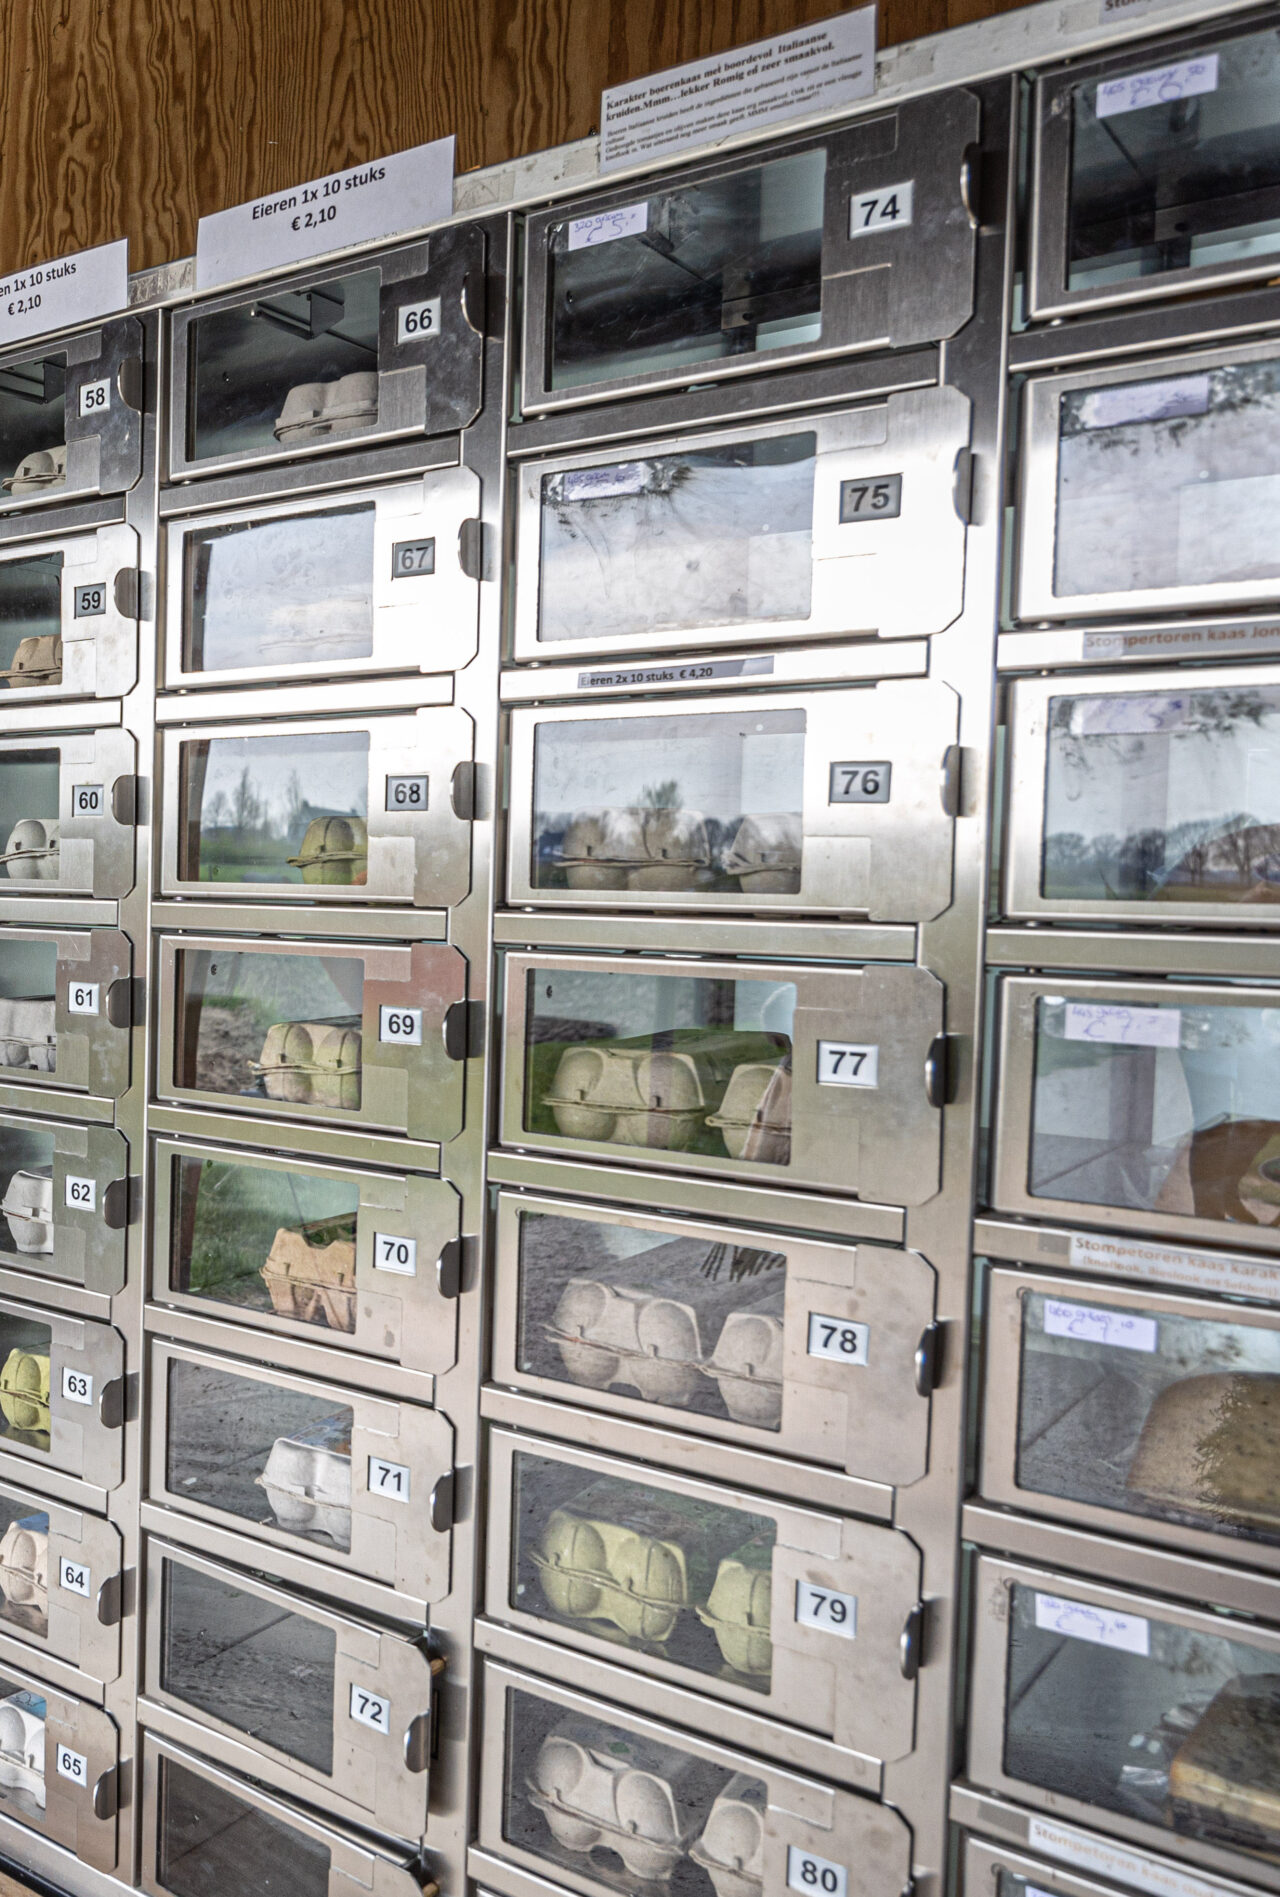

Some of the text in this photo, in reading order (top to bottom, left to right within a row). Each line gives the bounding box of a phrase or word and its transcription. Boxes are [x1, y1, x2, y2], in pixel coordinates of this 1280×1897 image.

[607, 91, 647, 110] Karakter
[649, 73, 701, 96] boerenkaas
[724, 48, 772, 72] boordevol
[778, 32, 827, 54] Italiaanse
[713, 70, 744, 87] Romig
[252, 167, 386, 221] Eieren 1x 10 stuks
[291, 205, 337, 232] € 2,10
[861, 194, 900, 227] 74
[14, 279, 26, 293] 1x
[30, 272, 43, 288] 10
[46, 262, 77, 282] stuks
[8, 295, 42, 316] € 2,10
[405, 307, 433, 333] 66
[85, 387, 106, 409] 58
[850, 484, 890, 512] 75
[401, 546, 428, 570] 67
[80, 591, 99, 611] 59
[1208, 628, 1246, 641] kaas
[580, 667, 713, 687] Eieren 2x 10 stuks € 4,20
[395, 782, 422, 805] 68
[840, 770, 880, 796] 76
[80, 792, 99, 810] 60
[75, 988, 93, 1008] 61
[389, 1014, 415, 1036] 69
[829, 1049, 868, 1077] 77
[71, 1182, 91, 1203] 62
[383, 1241, 409, 1265] 70
[1188, 1256, 1225, 1272] kaas
[821, 1324, 858, 1354] 78
[68, 1375, 88, 1397] 63
[379, 1466, 402, 1492] 71
[65, 1566, 85, 1588] 64
[811, 1593, 847, 1624] 79
[359, 1693, 383, 1724] 72
[63, 1753, 82, 1777] 65
[802, 1861, 838, 1893] 80
